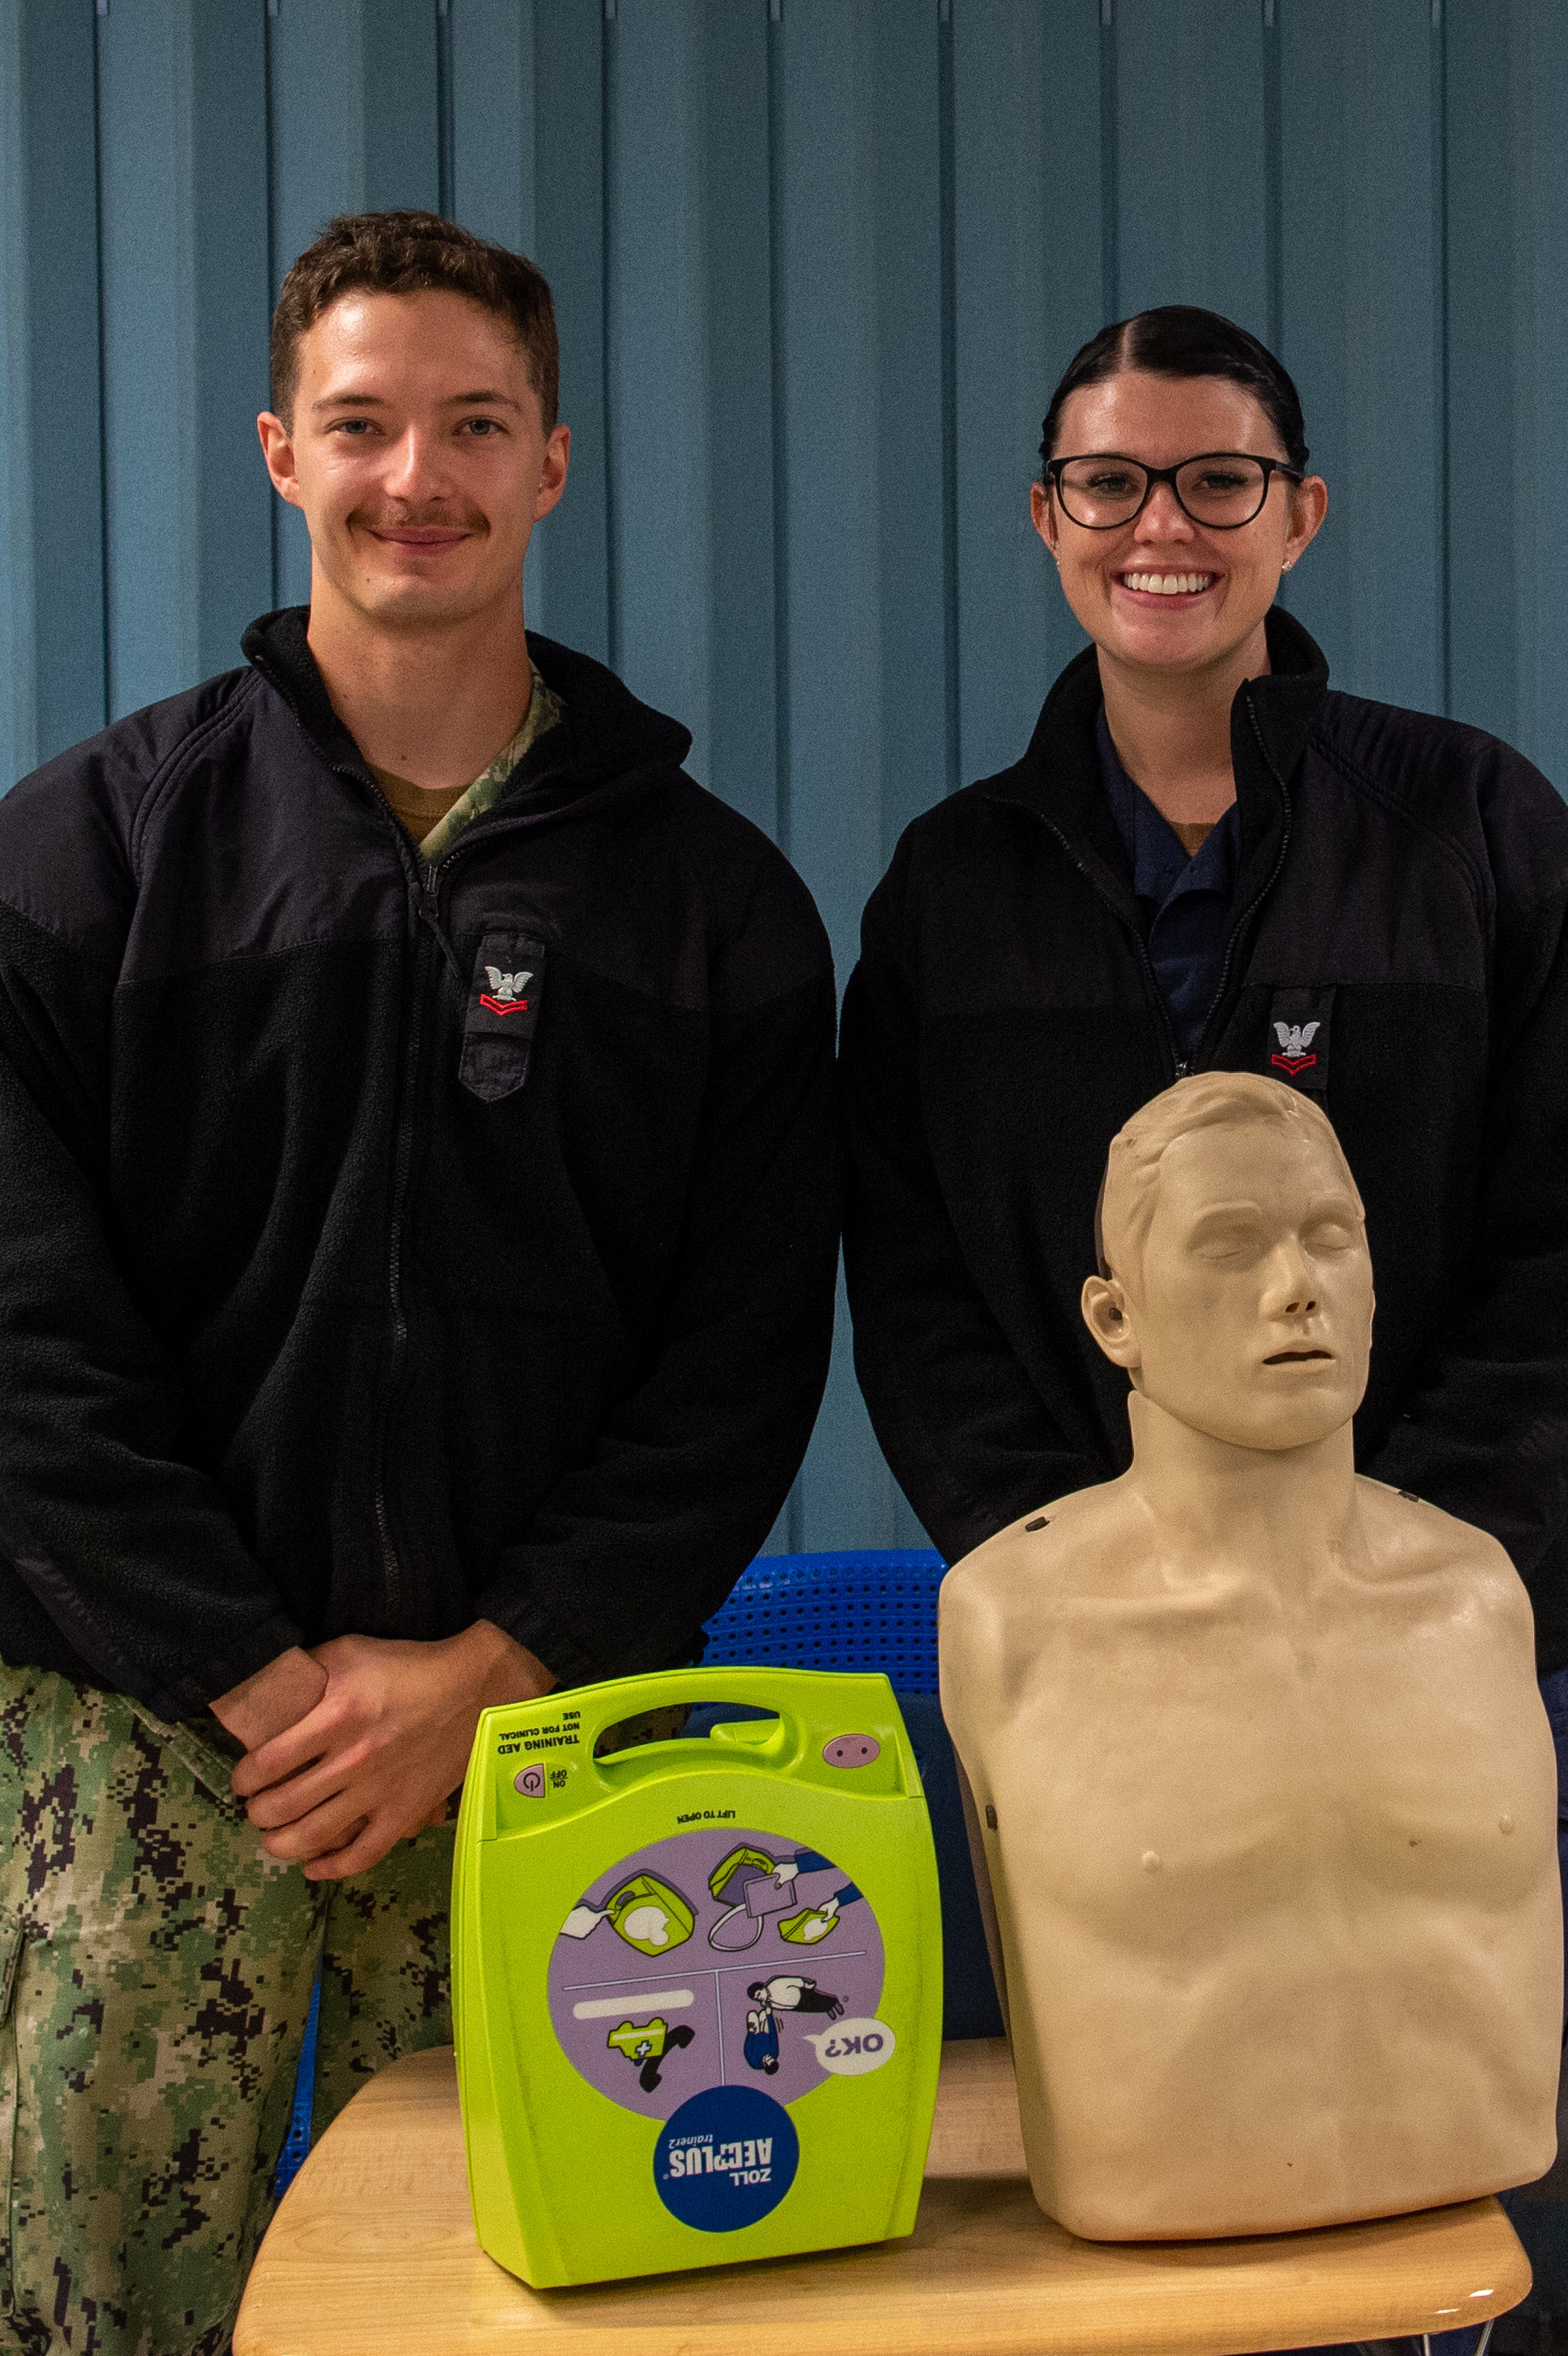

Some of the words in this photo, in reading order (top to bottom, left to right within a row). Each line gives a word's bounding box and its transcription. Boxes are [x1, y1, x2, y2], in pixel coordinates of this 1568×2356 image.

[562, 1711, 581, 1721] USE
[542, 1724, 560, 1734] FOR
[563, 1723, 580, 1731] NOT
[499, 1728, 539, 1740] CLINICAL
[524, 1734, 580, 1751] TRAINING
[497, 1742, 520, 1755] AED
[551, 1770, 568, 1779] OFF
[553, 1780, 566, 1788] ON
[677, 1812, 702, 1824] OPEN
[703, 1810, 715, 1819] TO
[717, 1810, 736, 1819] LIFT
[824, 2033, 884, 2058] OK?
[668, 2134, 713, 2149] trainer2
[729, 2167, 772, 2187] ZOLL
